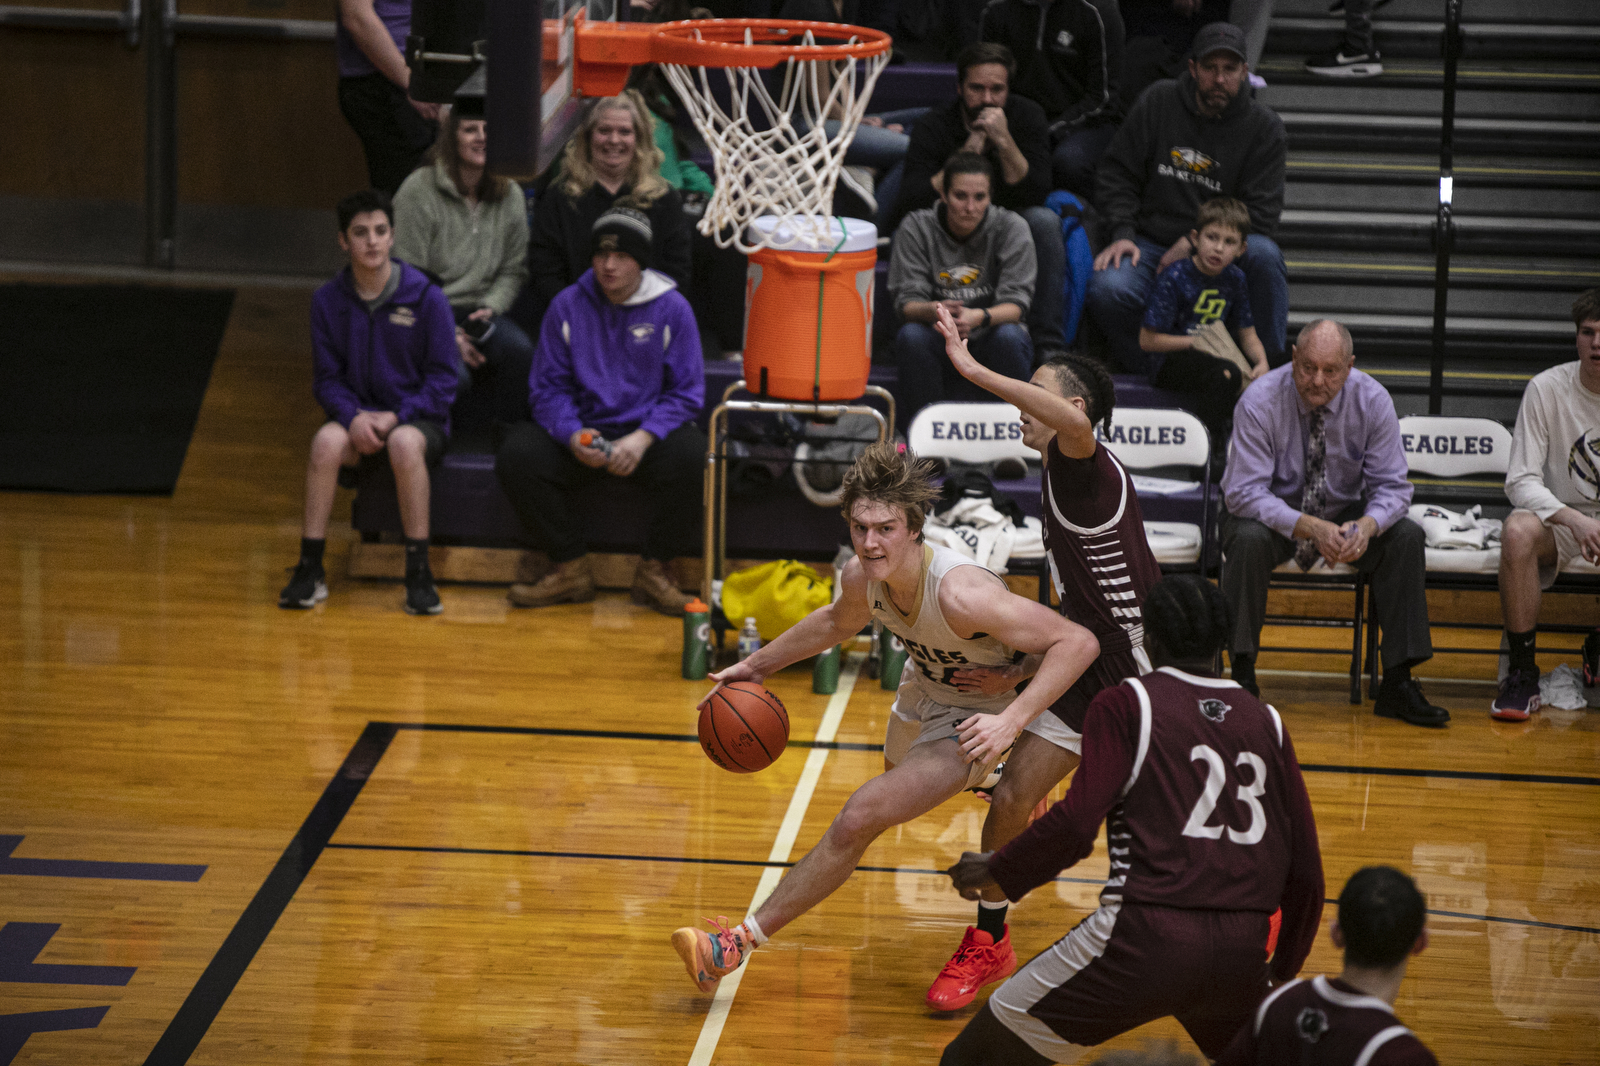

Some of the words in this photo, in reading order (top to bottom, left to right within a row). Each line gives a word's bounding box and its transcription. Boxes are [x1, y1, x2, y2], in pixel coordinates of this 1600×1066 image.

[932, 421, 1021, 441] EAGLES
[1096, 424, 1186, 445] EAGLES
[1401, 433, 1494, 455] EAGLES
[1181, 744, 1267, 845] 23
